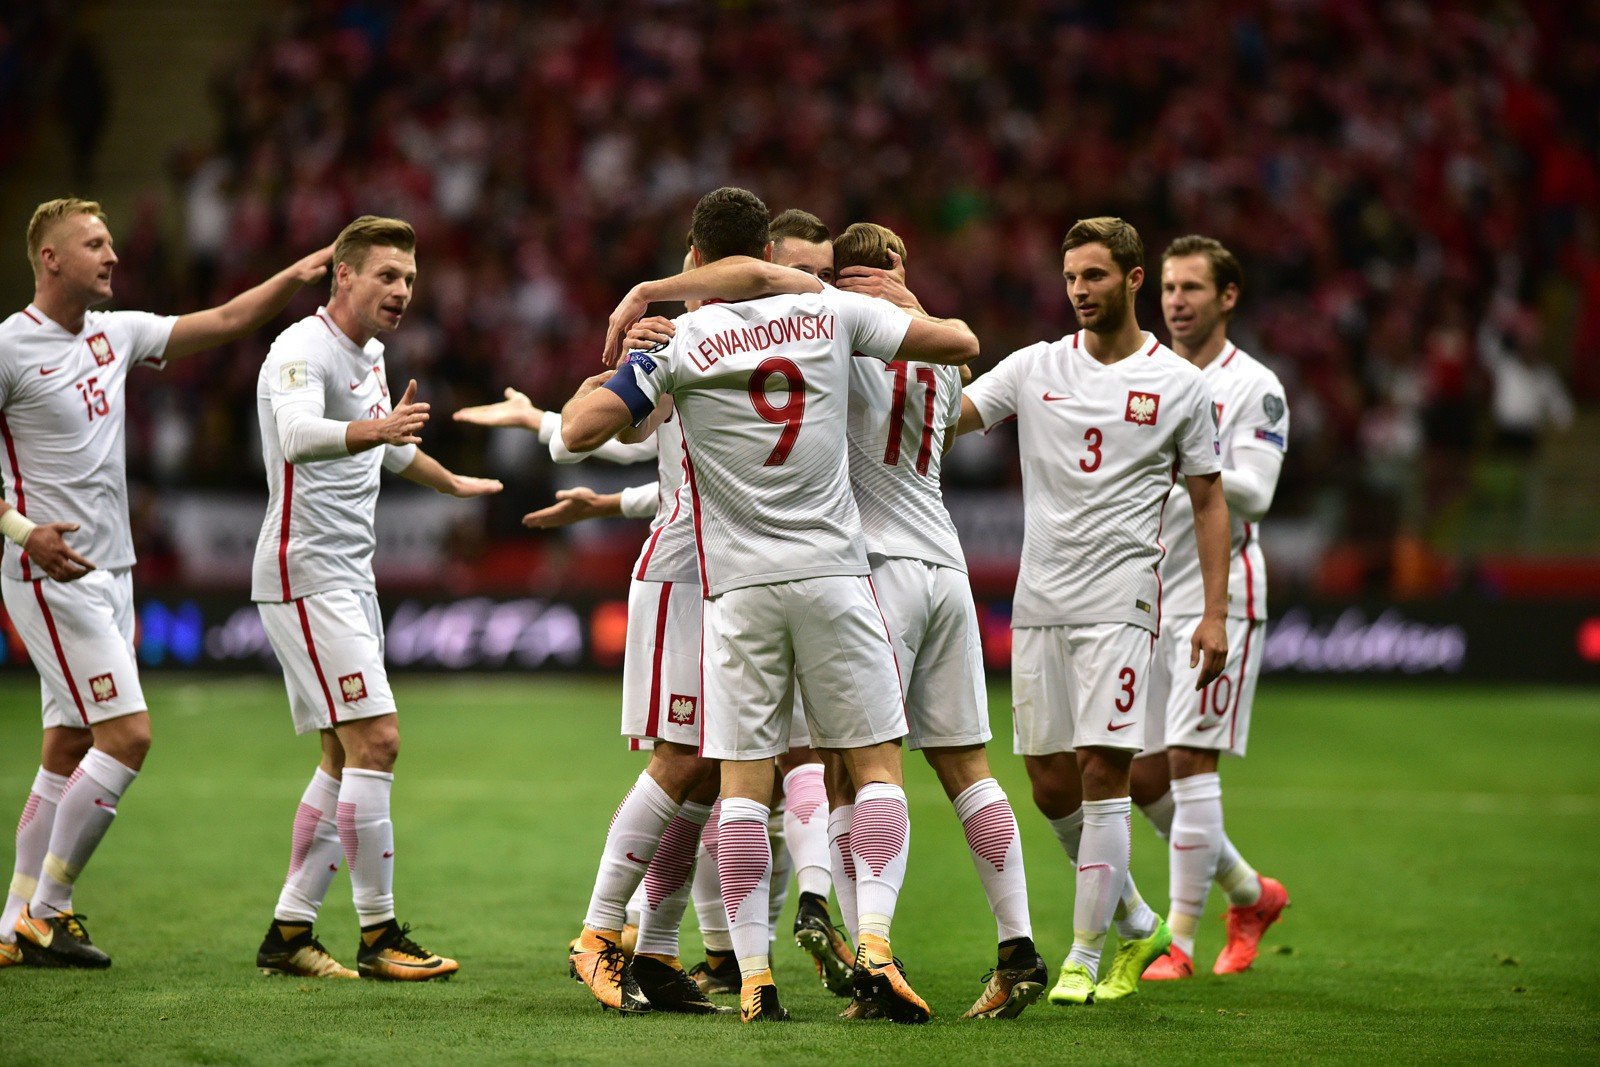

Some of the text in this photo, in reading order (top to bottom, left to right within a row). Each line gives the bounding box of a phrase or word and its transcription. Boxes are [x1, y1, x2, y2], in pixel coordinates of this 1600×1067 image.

[687, 315, 834, 372] LEWANDOWSKI
[76, 376, 110, 421] 15
[748, 356, 806, 467] 9
[882, 360, 937, 476] 11
[1079, 427, 1103, 473] 3
[1115, 666, 1136, 713] 3
[1200, 674, 1231, 716] 10
